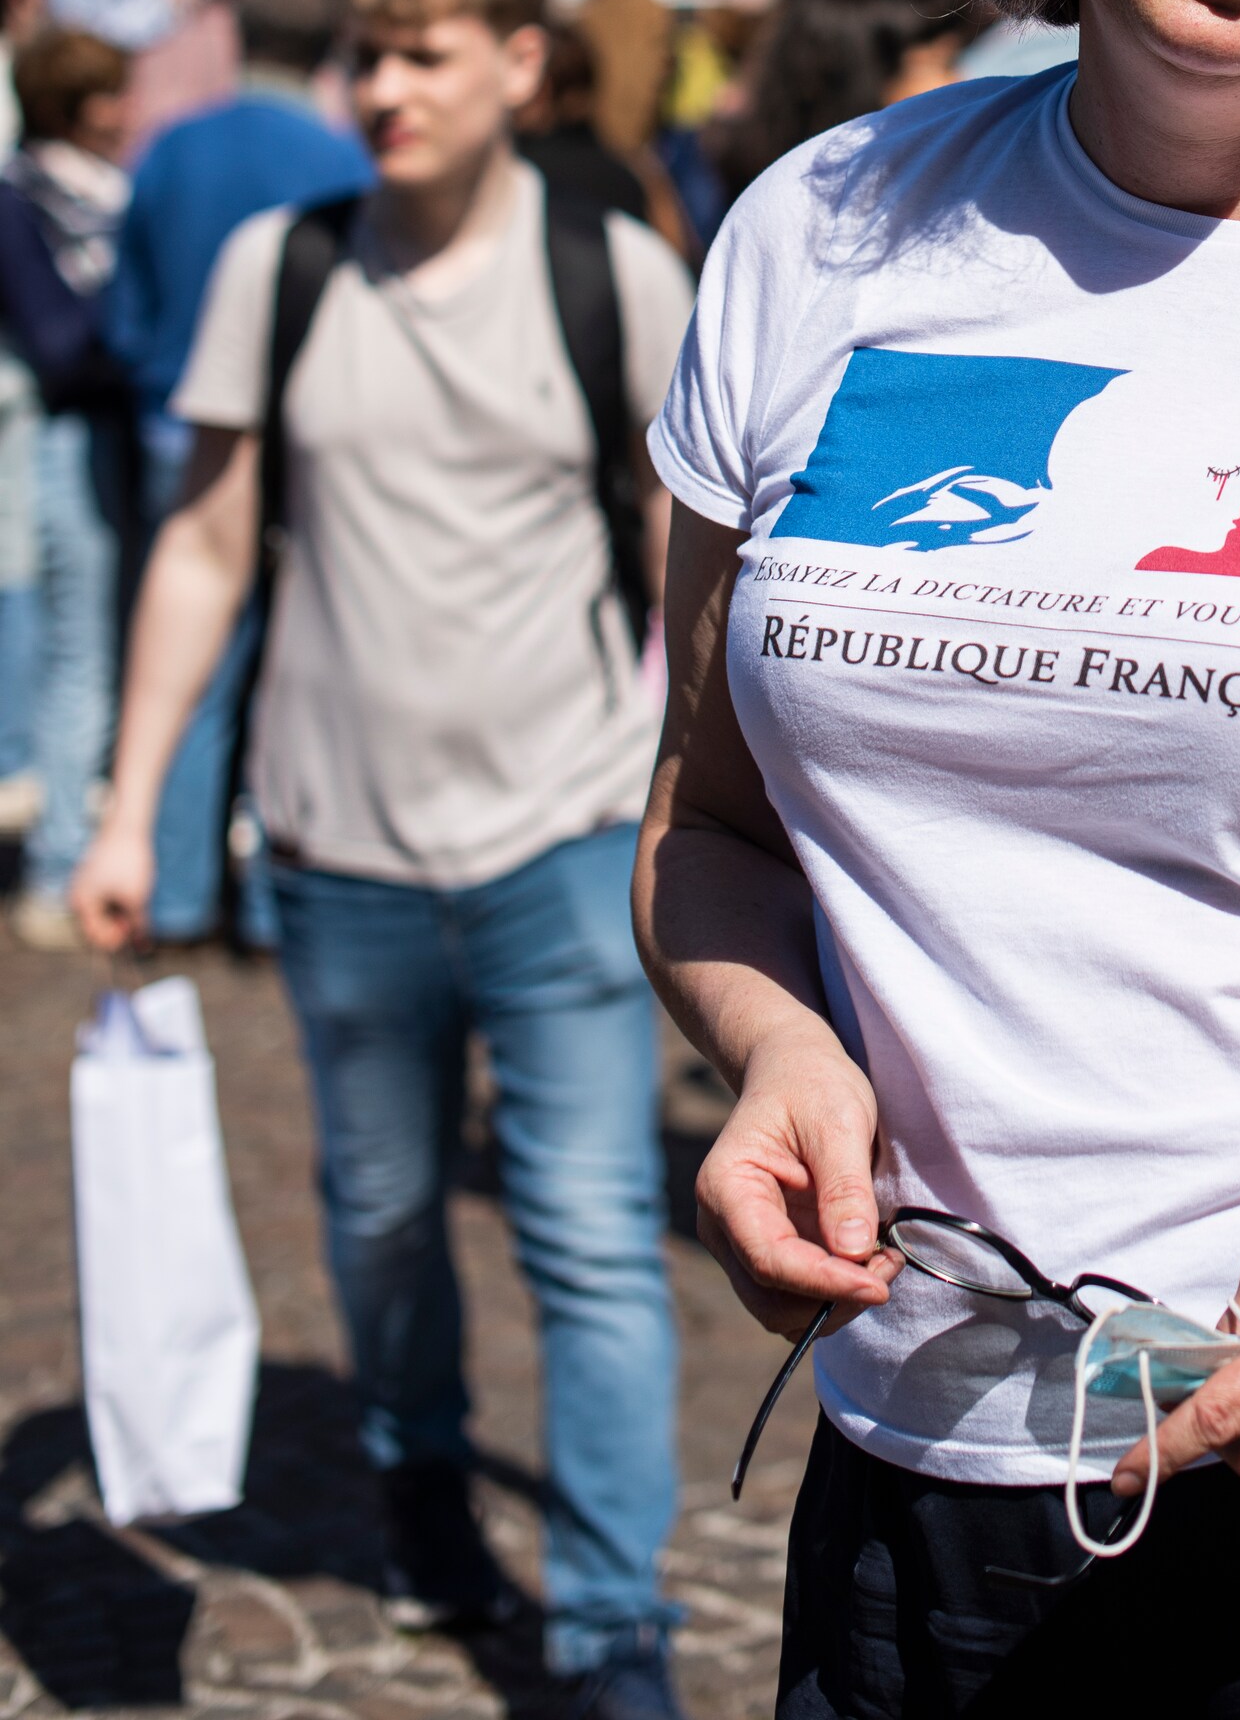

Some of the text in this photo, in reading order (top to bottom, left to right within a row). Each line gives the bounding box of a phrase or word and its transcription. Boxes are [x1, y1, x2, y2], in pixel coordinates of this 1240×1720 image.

[754, 556, 858, 588] ESSAYEZ
[862, 573, 902, 593] LA
[910, 579, 1110, 614] DICTATURE
[1117, 597, 1163, 618] ET
[760, 614, 1060, 685] RÉPUBLIQUE
